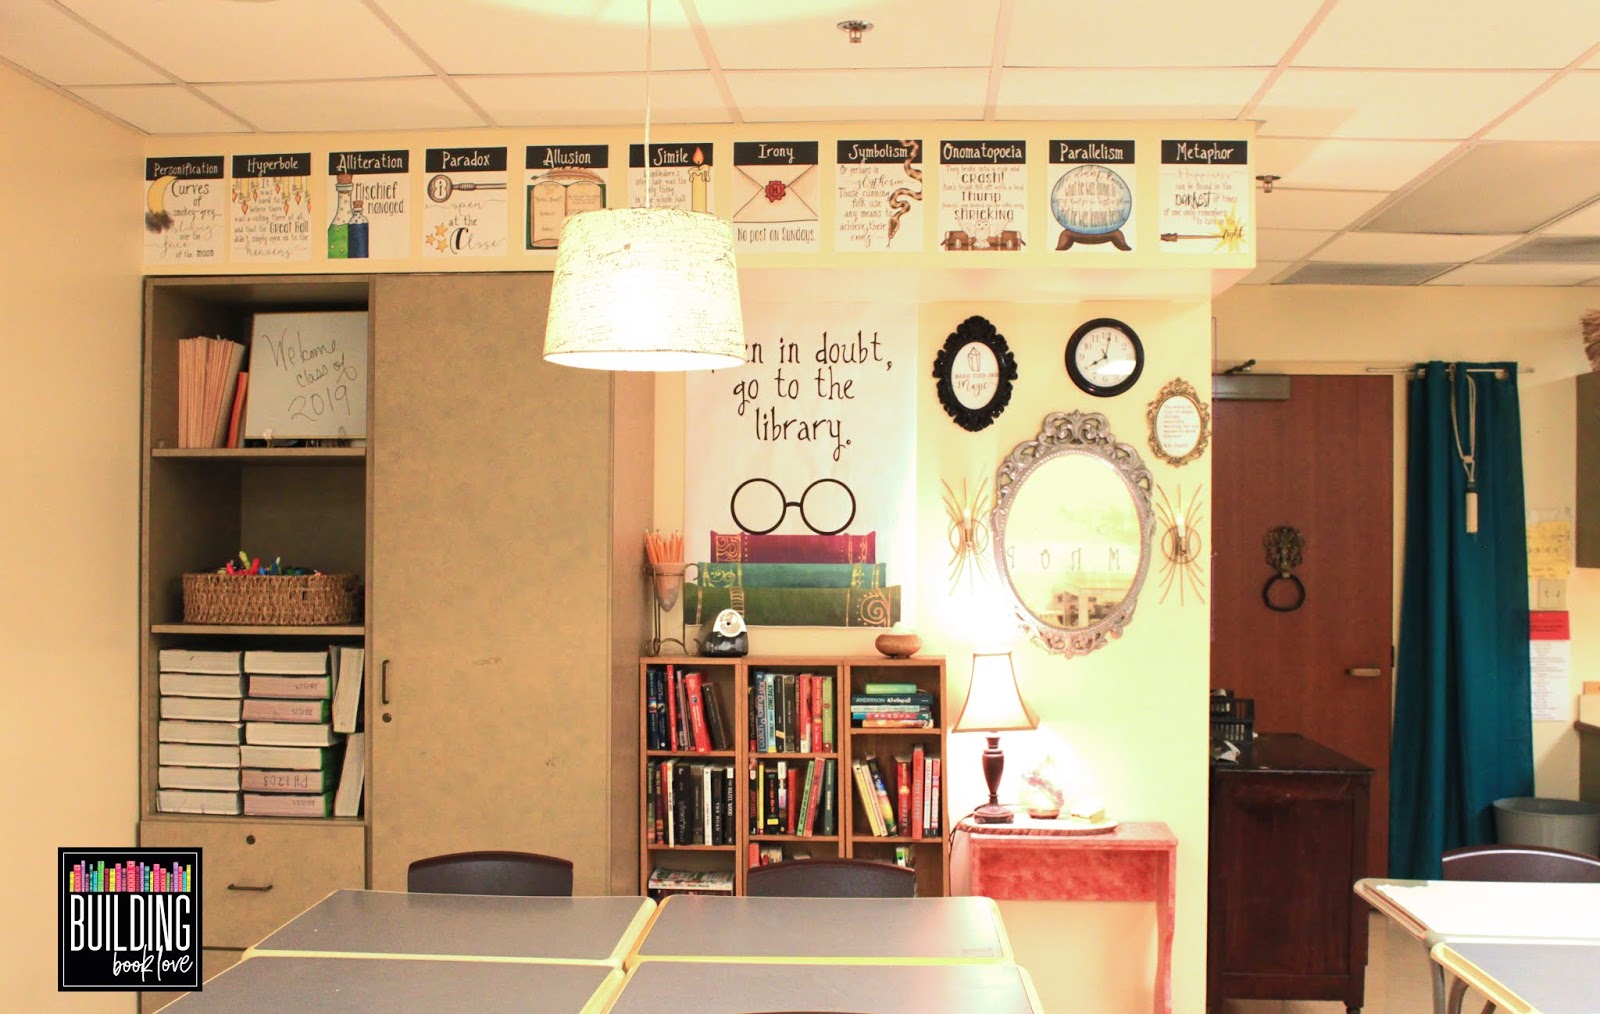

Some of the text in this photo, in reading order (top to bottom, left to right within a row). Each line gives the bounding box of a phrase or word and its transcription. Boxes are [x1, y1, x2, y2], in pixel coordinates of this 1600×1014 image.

[442, 150, 490, 170] Paradox
[542, 148, 592, 168] Allusion
[653, 147, 689, 166] Simile
[758, 144, 795, 164] Irony
[848, 144, 908, 164] Symbolism
[943, 142, 1022, 163] Onomatopoeia
[1060, 142, 1124, 162] Parallelism
[1176, 142, 1234, 164] Metaphor
[154, 162, 218, 176] Personification
[247, 157, 299, 177] Hyperbole
[336, 153, 403, 174] Alliteration
[171, 181, 210, 197] Curves
[355, 182, 398, 200] Mischief
[838, 187, 890, 201] Those cunning
[962, 191, 1001, 203] thump
[193, 196, 202, 207] of
[449, 215, 477, 226] at the
[844, 210, 858, 222] any
[738, 228, 747, 241] No
[750, 228, 766, 244] post
[262, 328, 336, 371] Welcome
[780, 337, 800, 364] in
[815, 330, 893, 371] doubt,
[333, 353, 357, 384] of
[733, 366, 855, 416] go to the
[288, 385, 350, 422] 2019
[755, 406, 852, 462] library.
